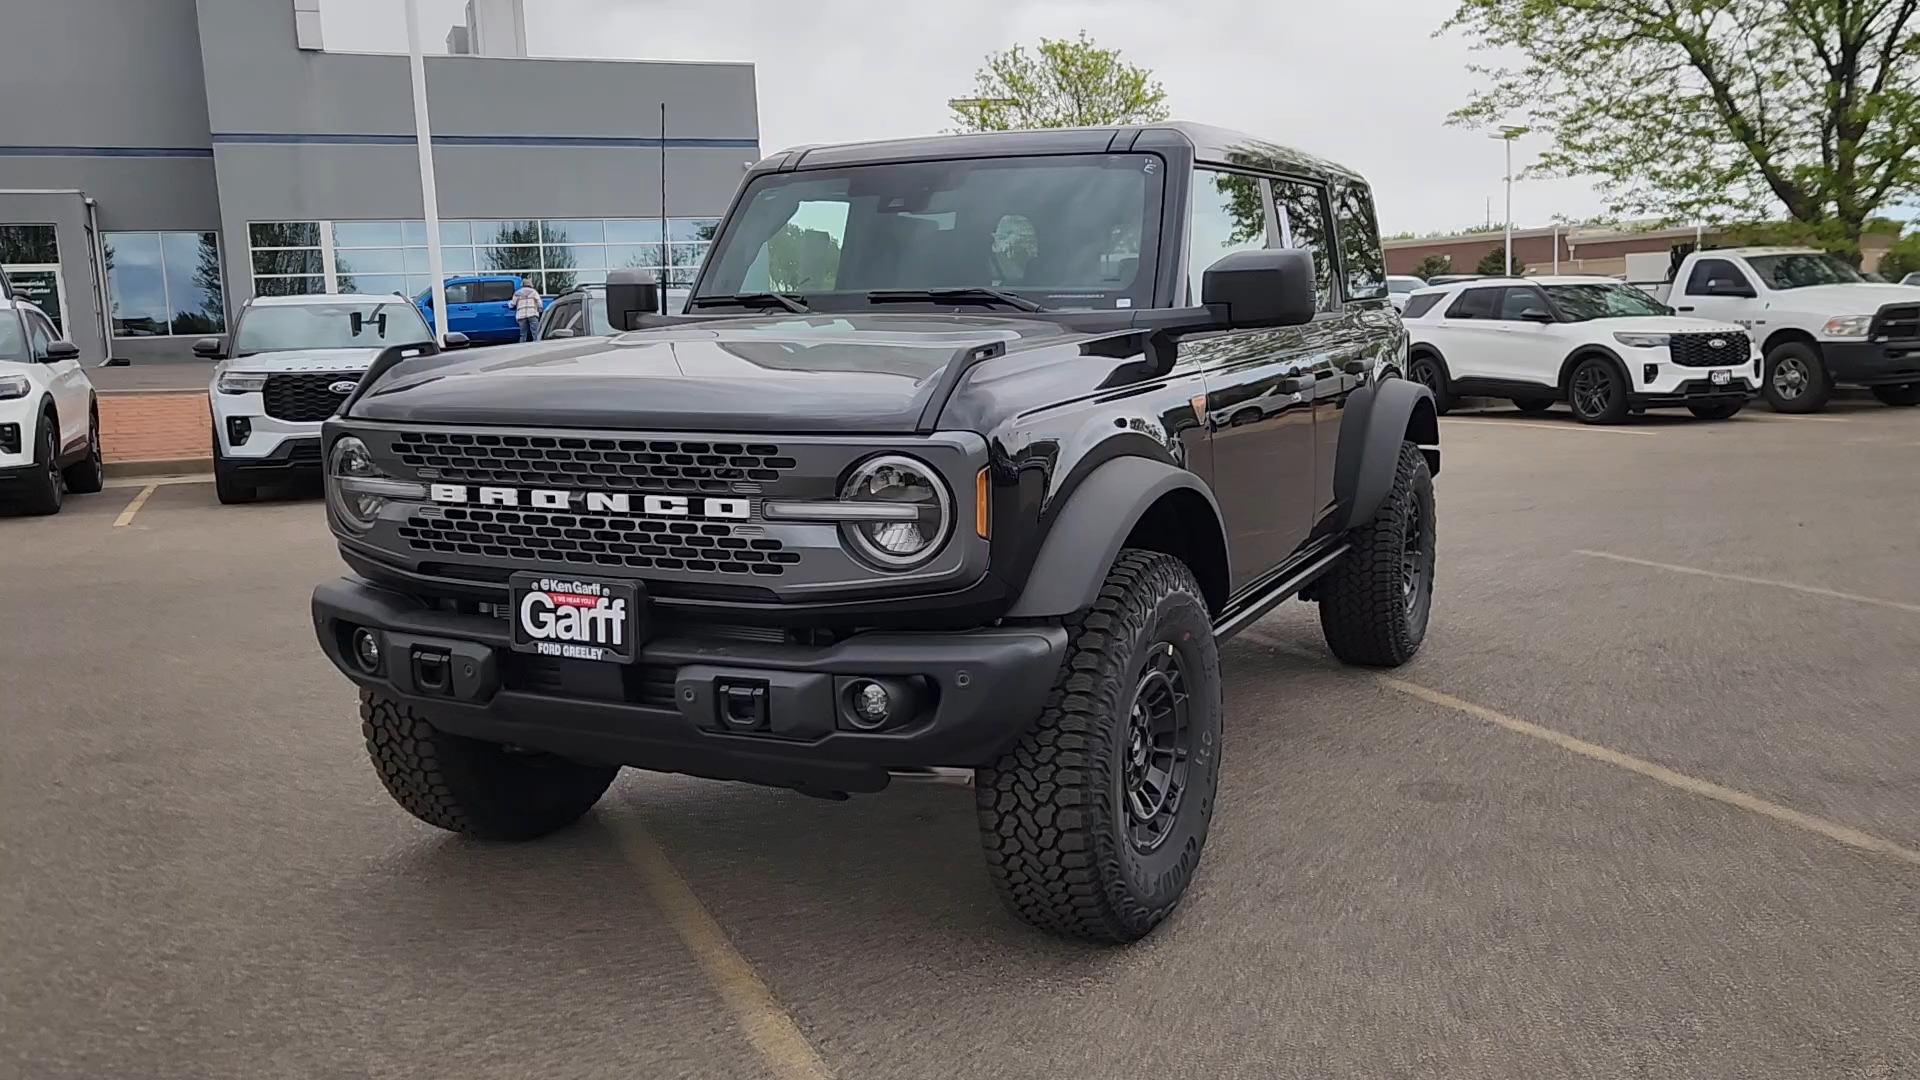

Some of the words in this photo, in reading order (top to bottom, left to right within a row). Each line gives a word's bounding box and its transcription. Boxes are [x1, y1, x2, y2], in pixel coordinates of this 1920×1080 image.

[430, 483, 751, 519] BRONCO
[550, 579, 572, 593] Ken
[572, 581, 601, 596] Garff
[520, 591, 626, 645] Garff
[537, 642, 561, 656] FORD
[562, 646, 603, 660] GREELEY
